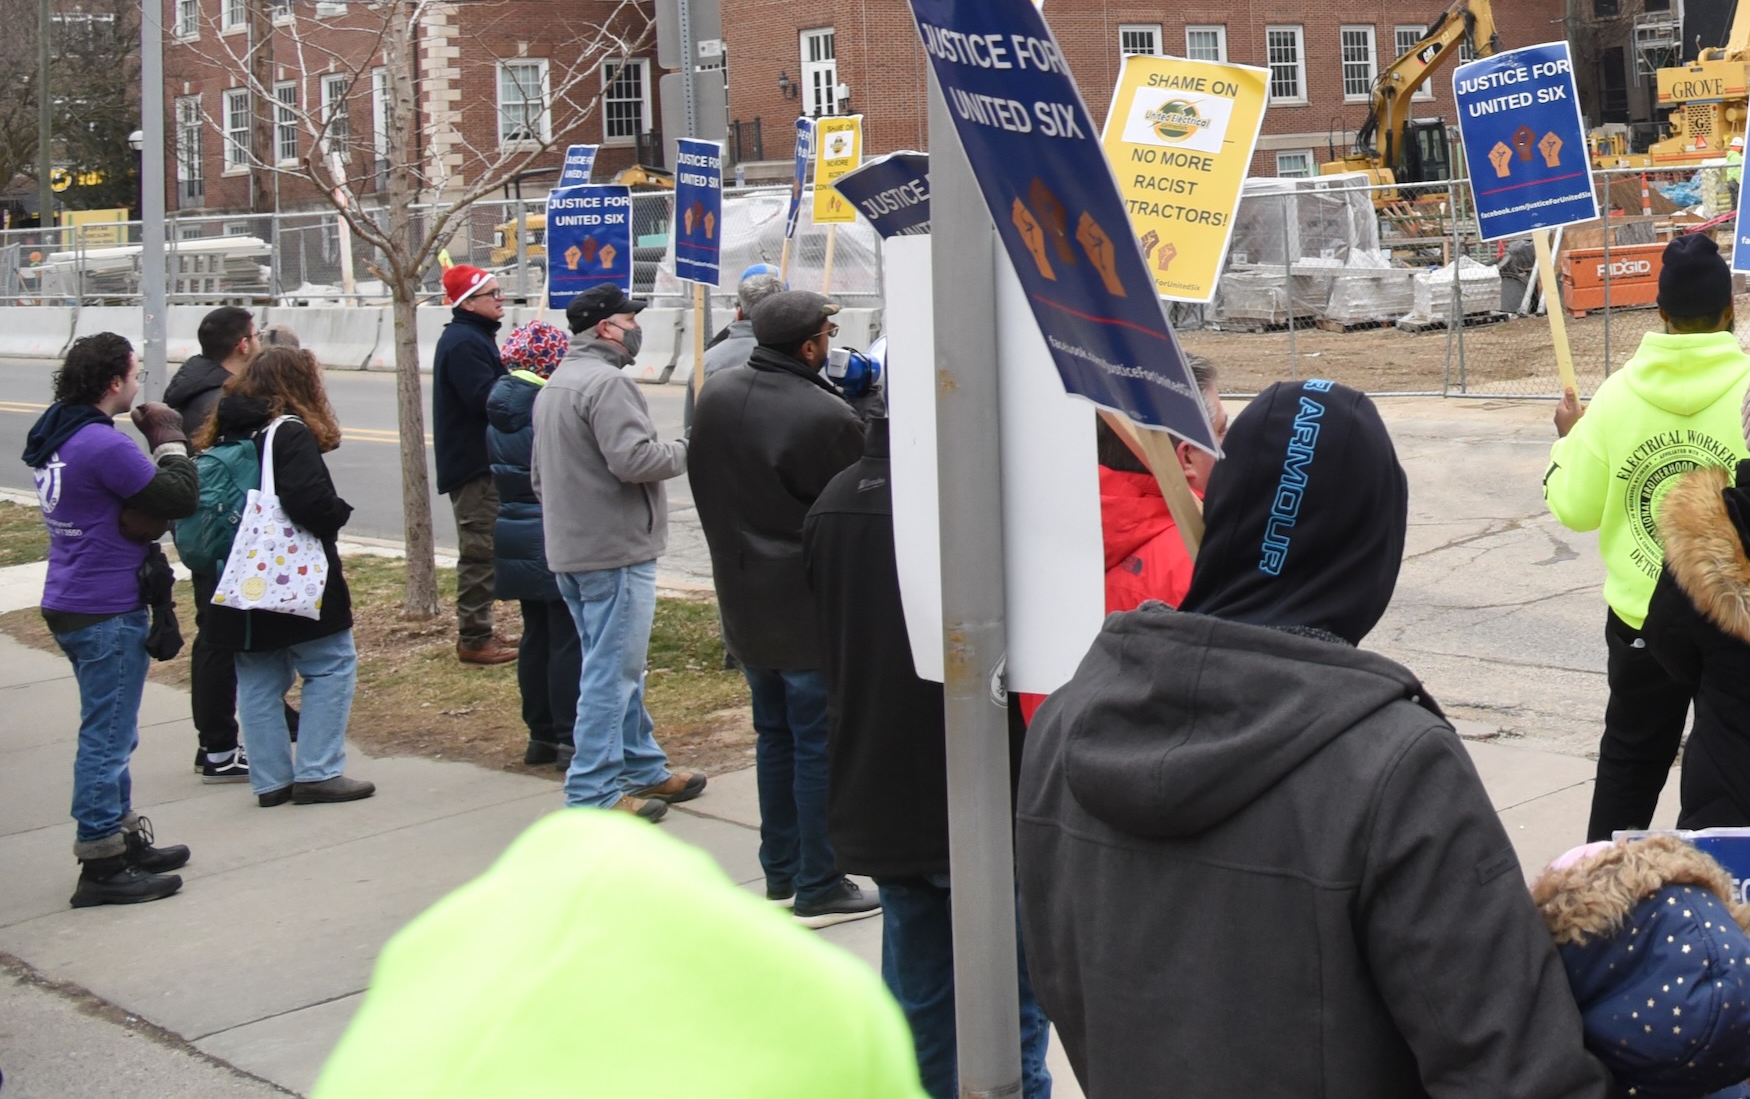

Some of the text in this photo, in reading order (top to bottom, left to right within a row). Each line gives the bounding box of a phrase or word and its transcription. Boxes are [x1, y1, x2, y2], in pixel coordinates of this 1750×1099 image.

[921, 22, 1069, 76] JUSTICE FOR
[1422, 45, 1436, 63] CAT
[1147, 73, 1239, 97] SHAME ON
[1458, 59, 1571, 95] JUSTICE FOR
[1672, 78, 1723, 99] GROVE
[949, 85, 1086, 140] UNITED SIX
[1469, 85, 1566, 117] UNITED SIX
[1145, 110, 1211, 129] United Electrical
[678, 153, 707, 168] JUSTICE
[1131, 148, 1213, 172] NO MORE
[680, 172, 706, 187] UNITED
[1133, 174, 1198, 196] RACIST
[549, 196, 630, 210] JUSTICE FOR
[862, 178, 930, 220] JUSTICE
[556, 213, 625, 227] UNITED SIX
[1127, 199, 1228, 227] TRACTORS!
[1616, 429, 1684, 481] ELECTRICAL
[1259, 396, 1326, 576] ARMOUR
[1644, 461, 1694, 498] BROTHERHOOD
